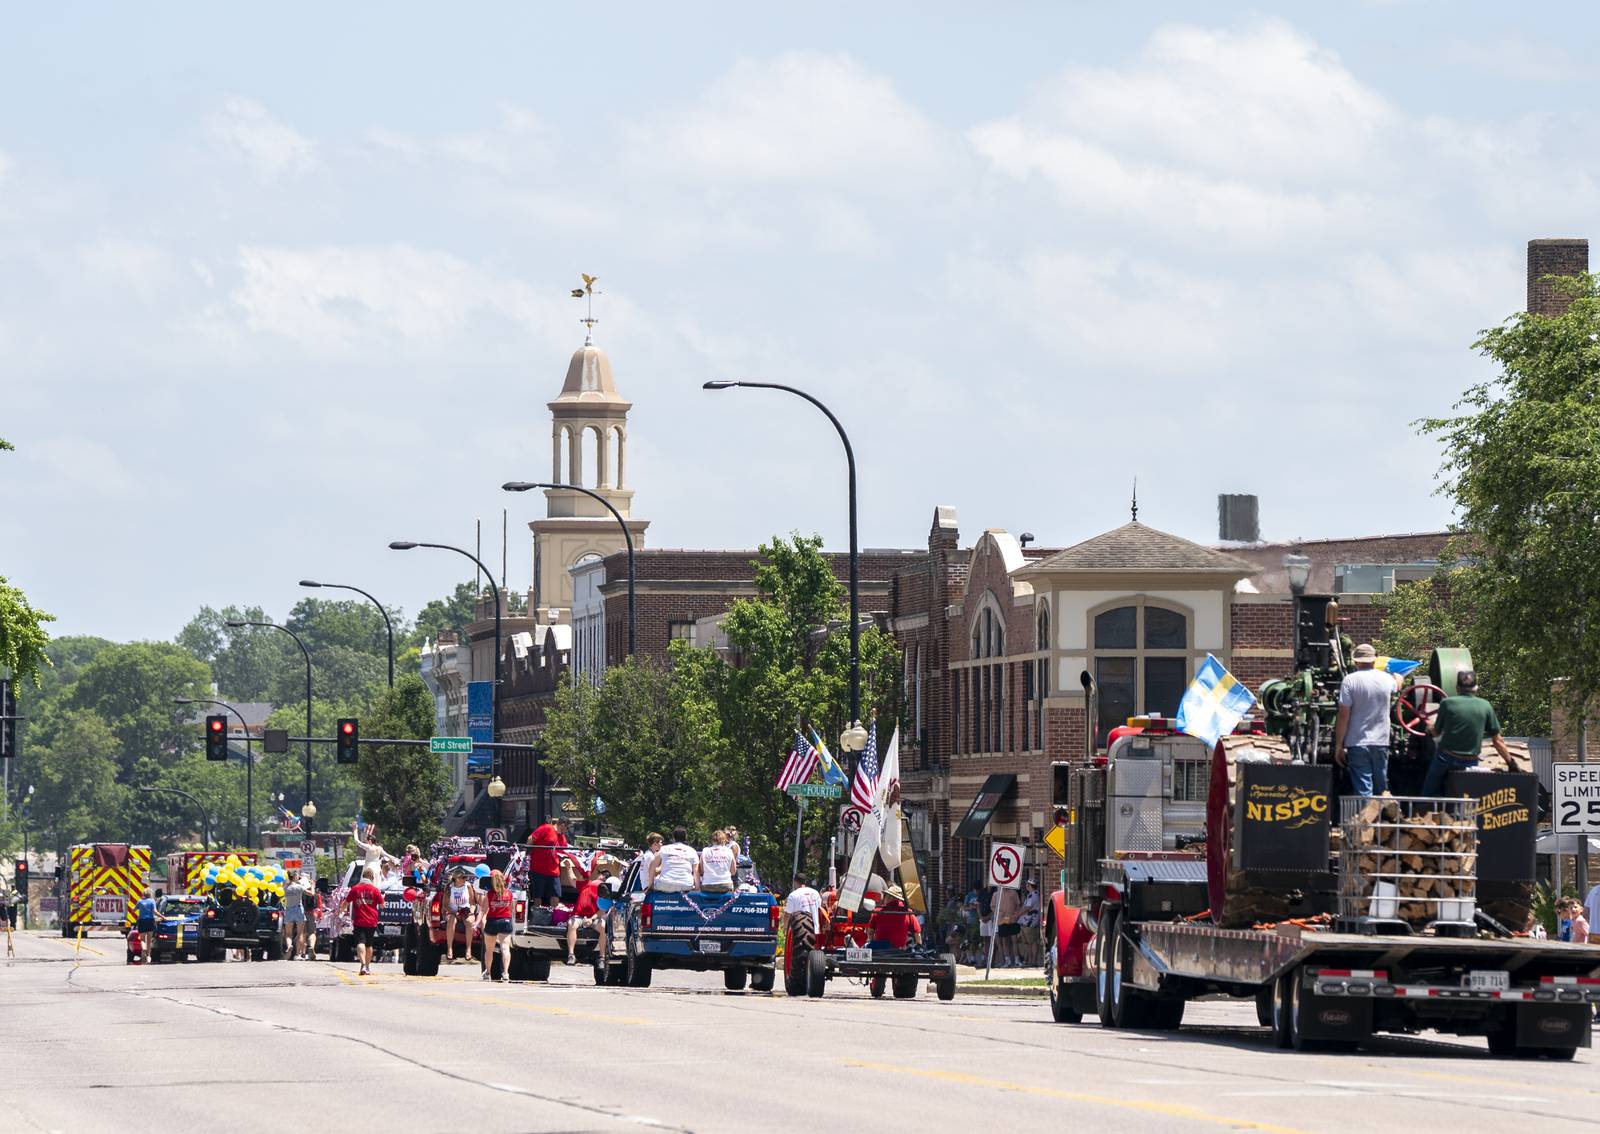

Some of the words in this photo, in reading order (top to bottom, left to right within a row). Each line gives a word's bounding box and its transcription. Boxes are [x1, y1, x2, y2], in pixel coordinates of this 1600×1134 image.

[433, 741, 445, 749] 3rd
[447, 741, 470, 749] Street
[1558, 771, 1600, 782] SPEE
[807, 786, 835, 796] FOURTH
[1564, 786, 1600, 797] LIMIT
[1247, 795, 1328, 821] NISPC
[1561, 801, 1600, 826] 25
[1483, 808, 1529, 830] ENGINE
[95, 899, 124, 913] GENEVA
[383, 900, 413, 909] embo
